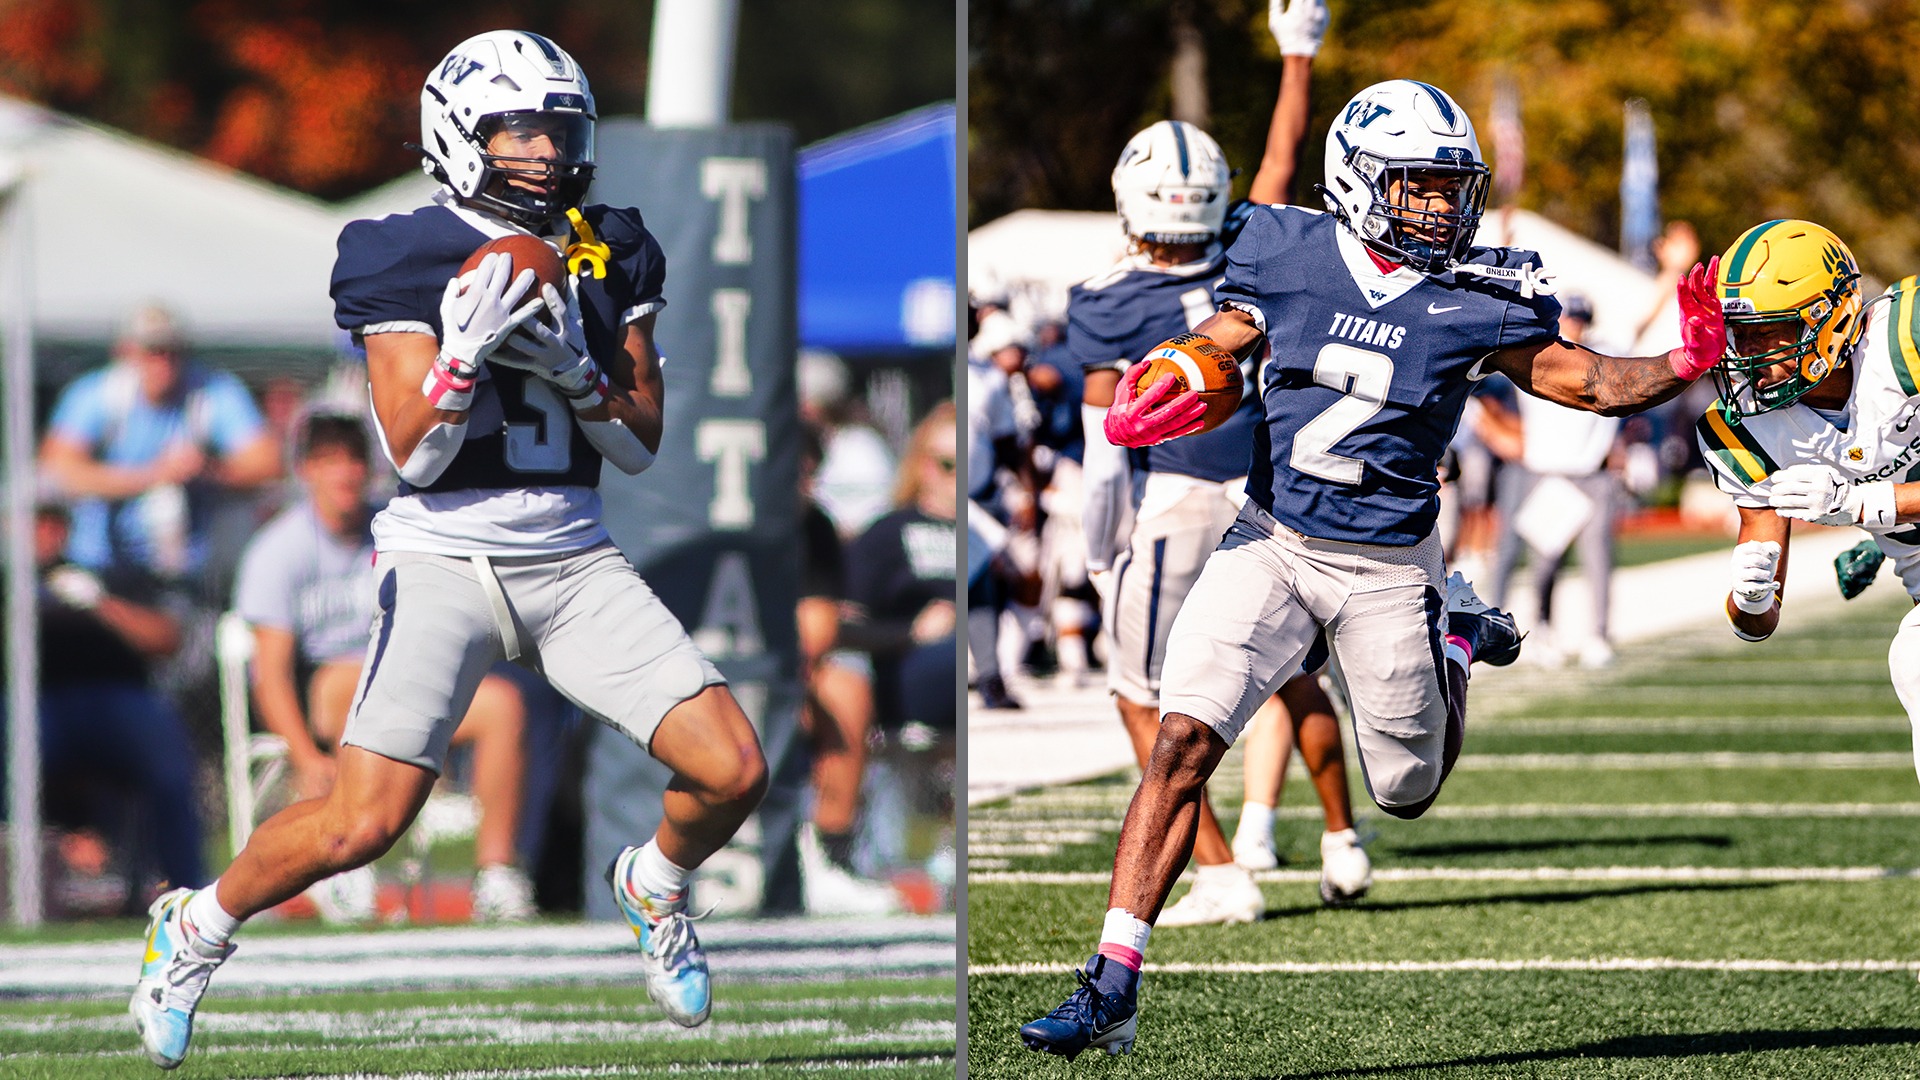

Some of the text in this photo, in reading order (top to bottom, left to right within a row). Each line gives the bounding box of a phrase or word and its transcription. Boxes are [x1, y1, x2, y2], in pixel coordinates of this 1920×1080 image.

[1485, 266, 1517, 278] NXTRND
[1328, 312, 1407, 350] TITANS
[1289, 342, 1394, 487] 2
[1852, 436, 1920, 487] ARCATS
